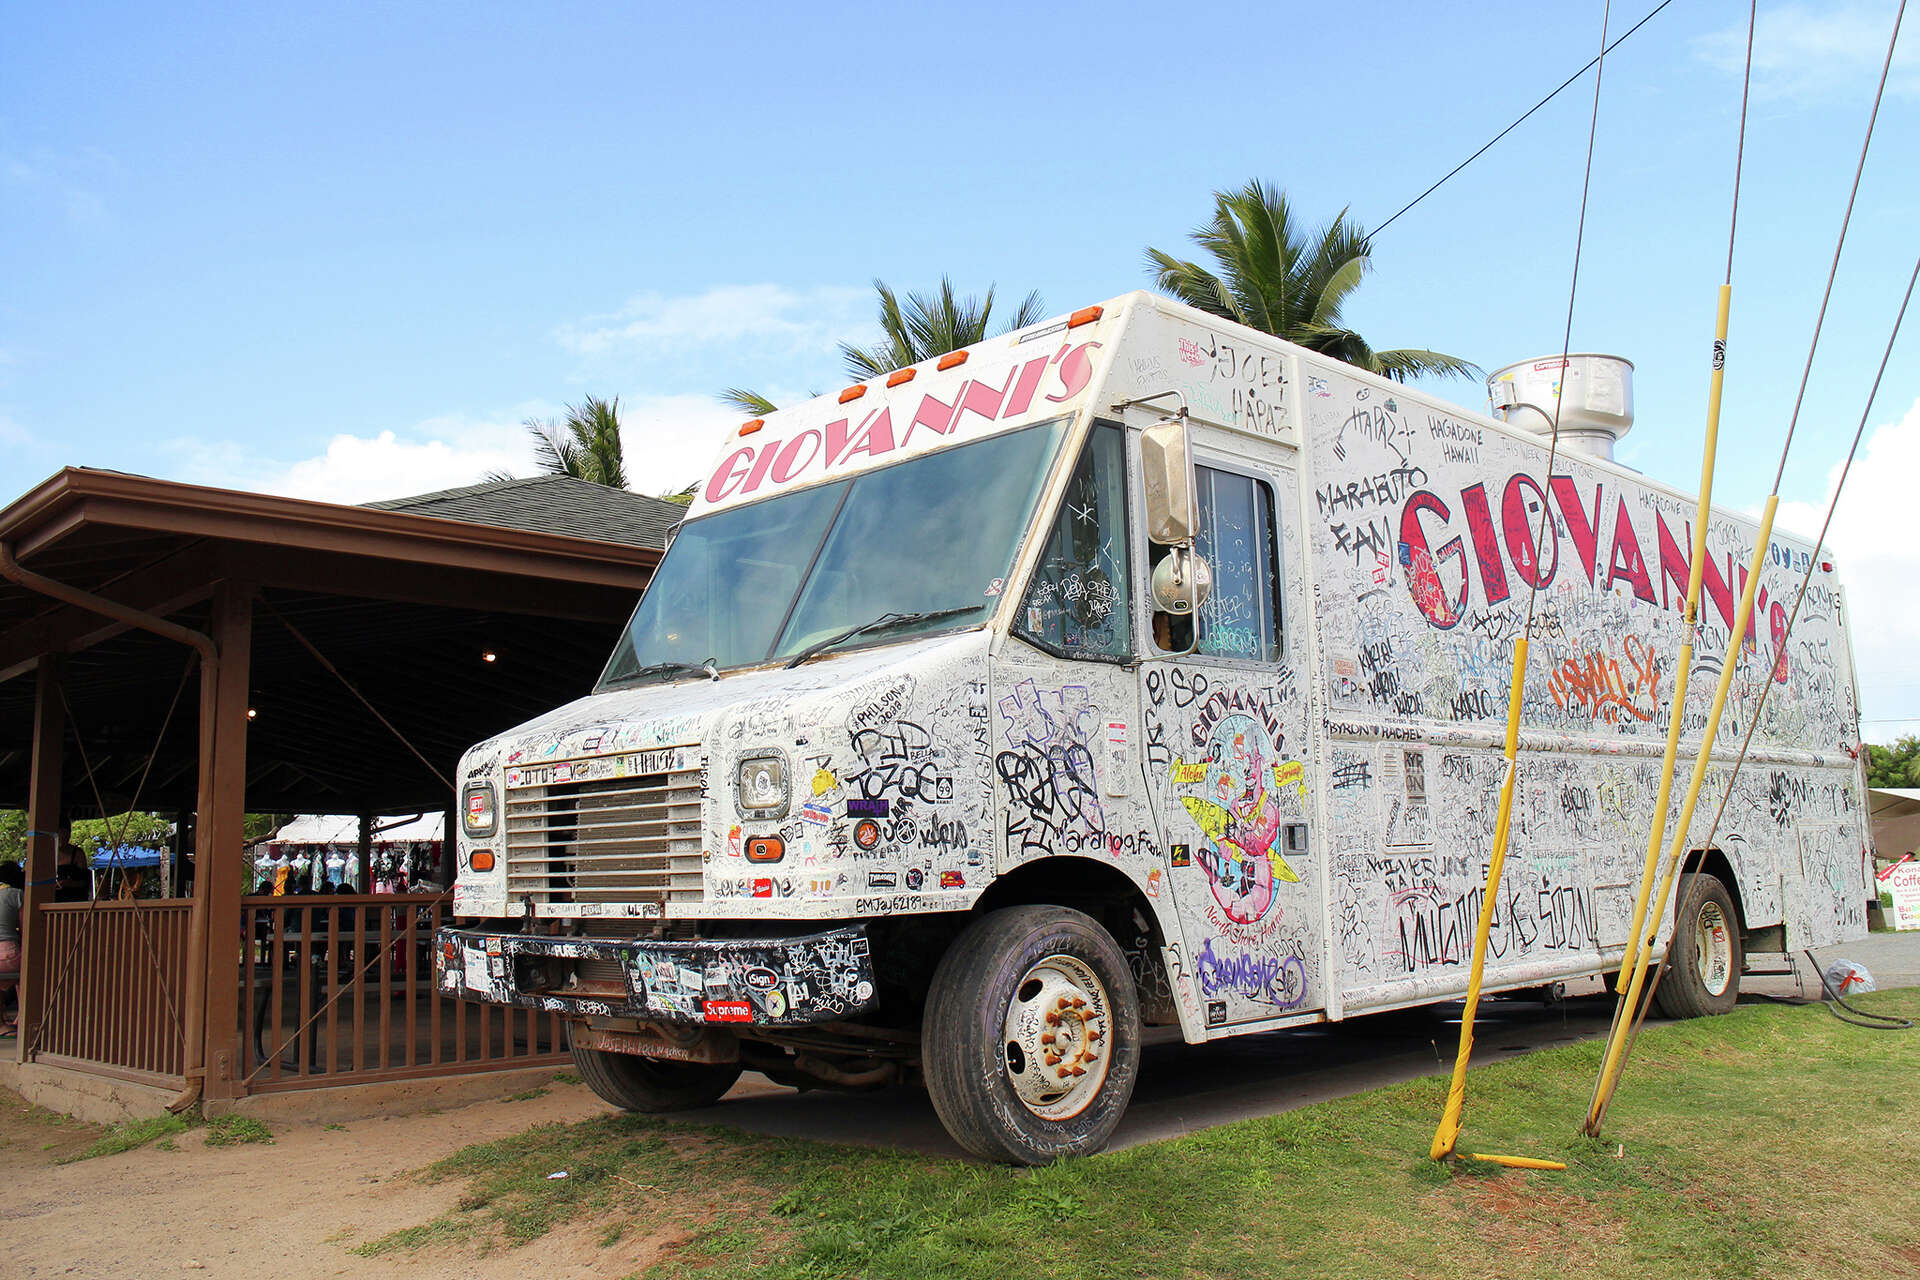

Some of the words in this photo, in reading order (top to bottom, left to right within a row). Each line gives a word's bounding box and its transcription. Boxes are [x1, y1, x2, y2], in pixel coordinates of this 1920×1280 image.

[704, 341, 1103, 503] GIOVANNI'S
[1427, 415, 1484, 446] HAGADONE
[1443, 445, 1480, 464] HAWAII
[856, 686, 902, 728] PHILSON
[1191, 688, 1287, 753] GIOVANNI'S
[1329, 721, 1370, 736] BYRON
[939, 785, 951, 796] 99
[1897, 866, 1920, 874] Kon
[1203, 904, 1232, 937] North
[1260, 903, 1285, 945] Hawaii
[706, 1001, 750, 1019] Supreme
